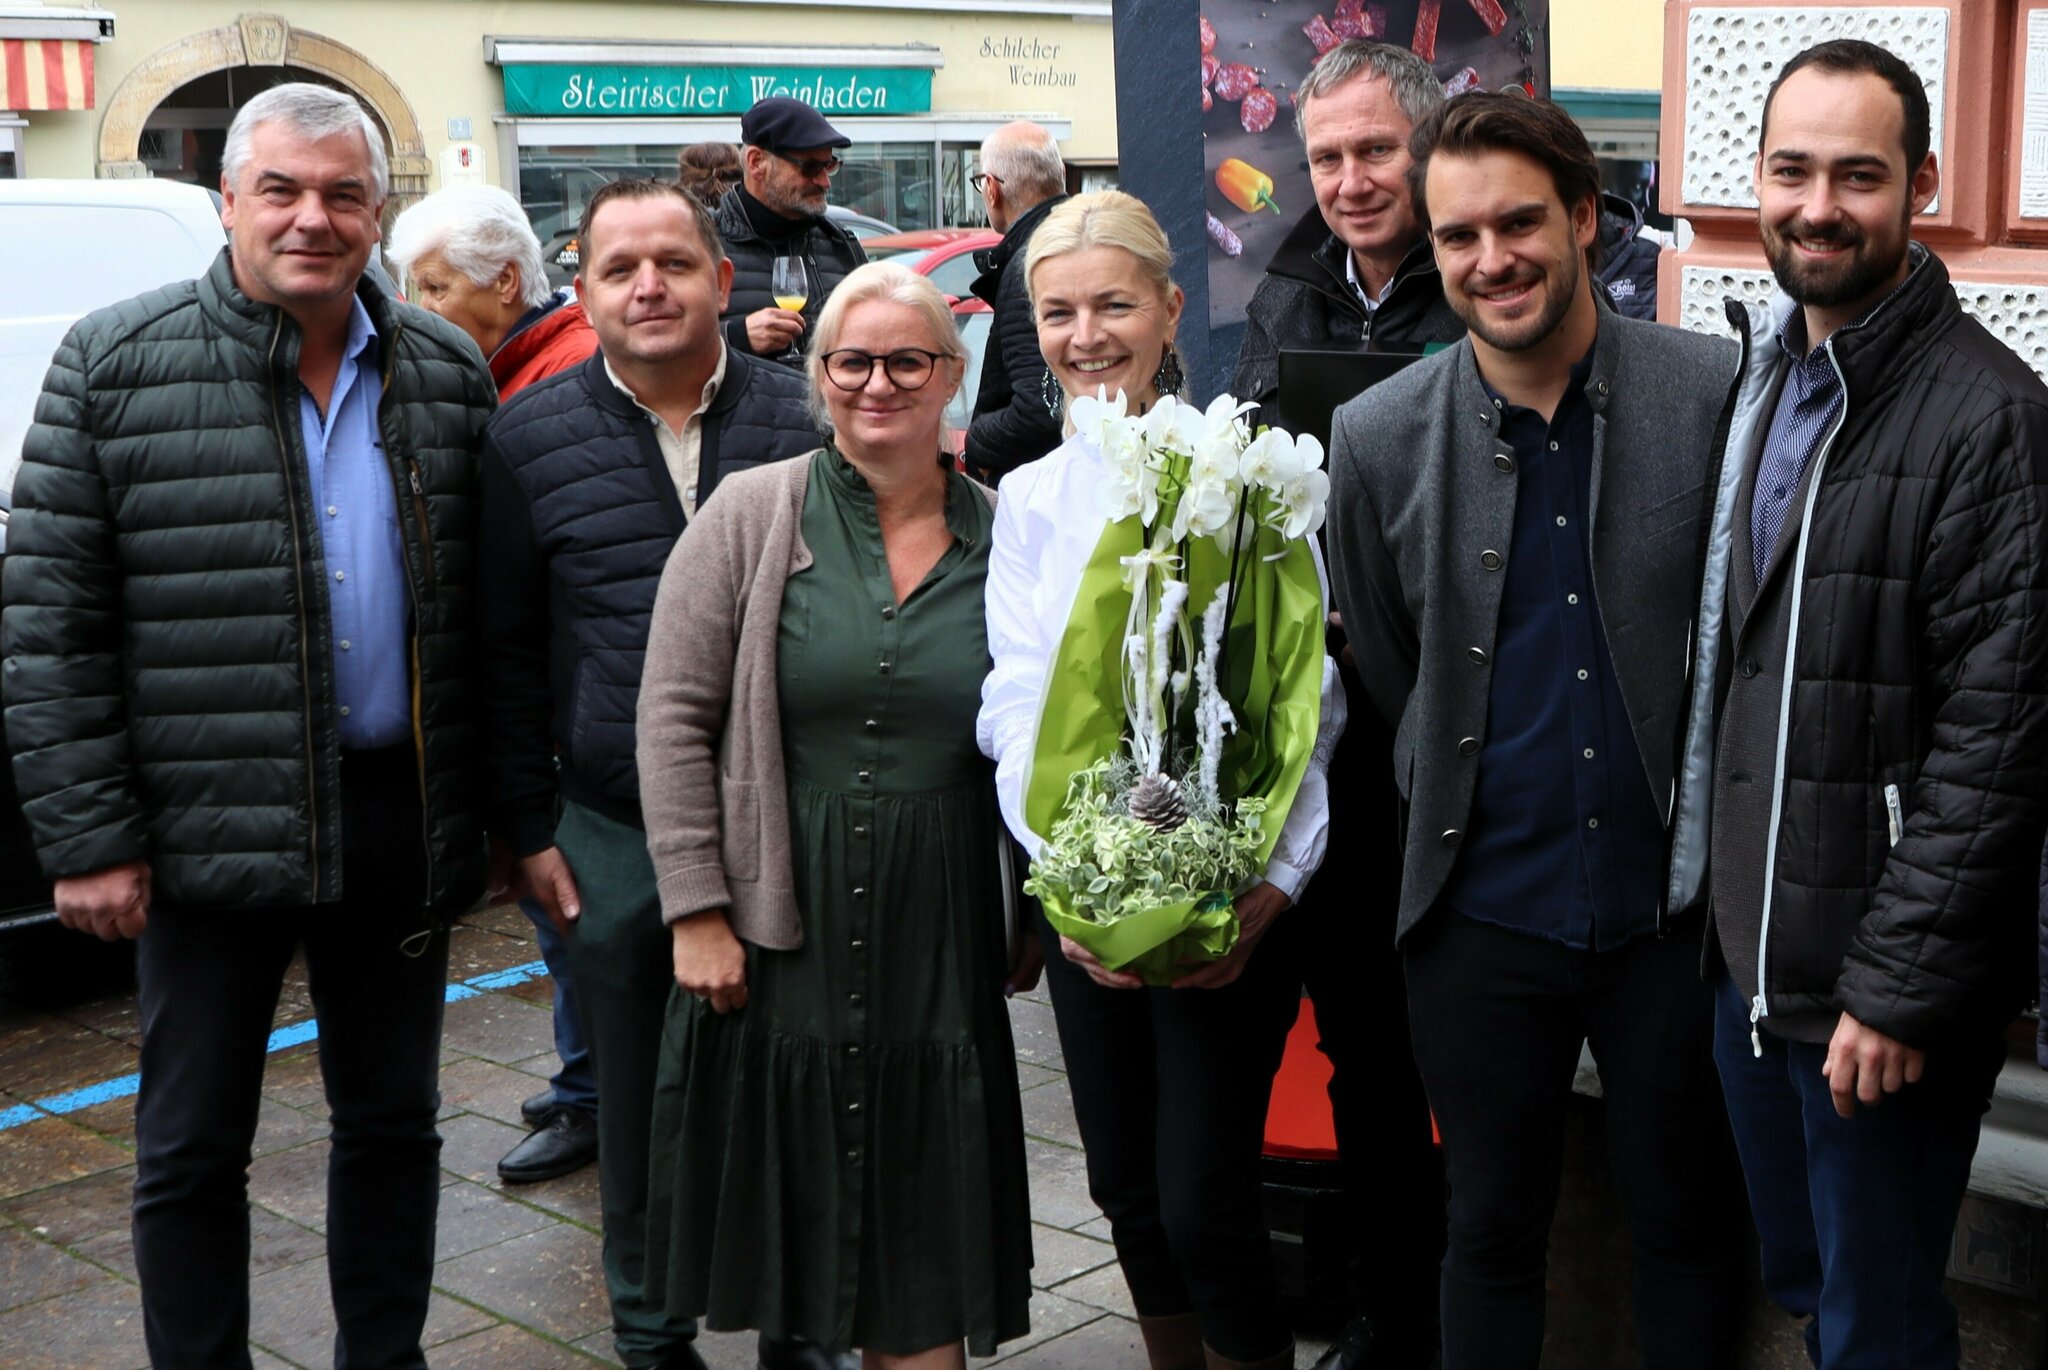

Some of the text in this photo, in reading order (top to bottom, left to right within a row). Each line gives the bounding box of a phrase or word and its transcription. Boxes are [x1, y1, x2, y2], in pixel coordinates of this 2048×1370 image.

[979, 36, 1060, 59] Schilcher
[1009, 64, 1076, 87] Weinbau
[562, 73, 729, 109] Steirischer
